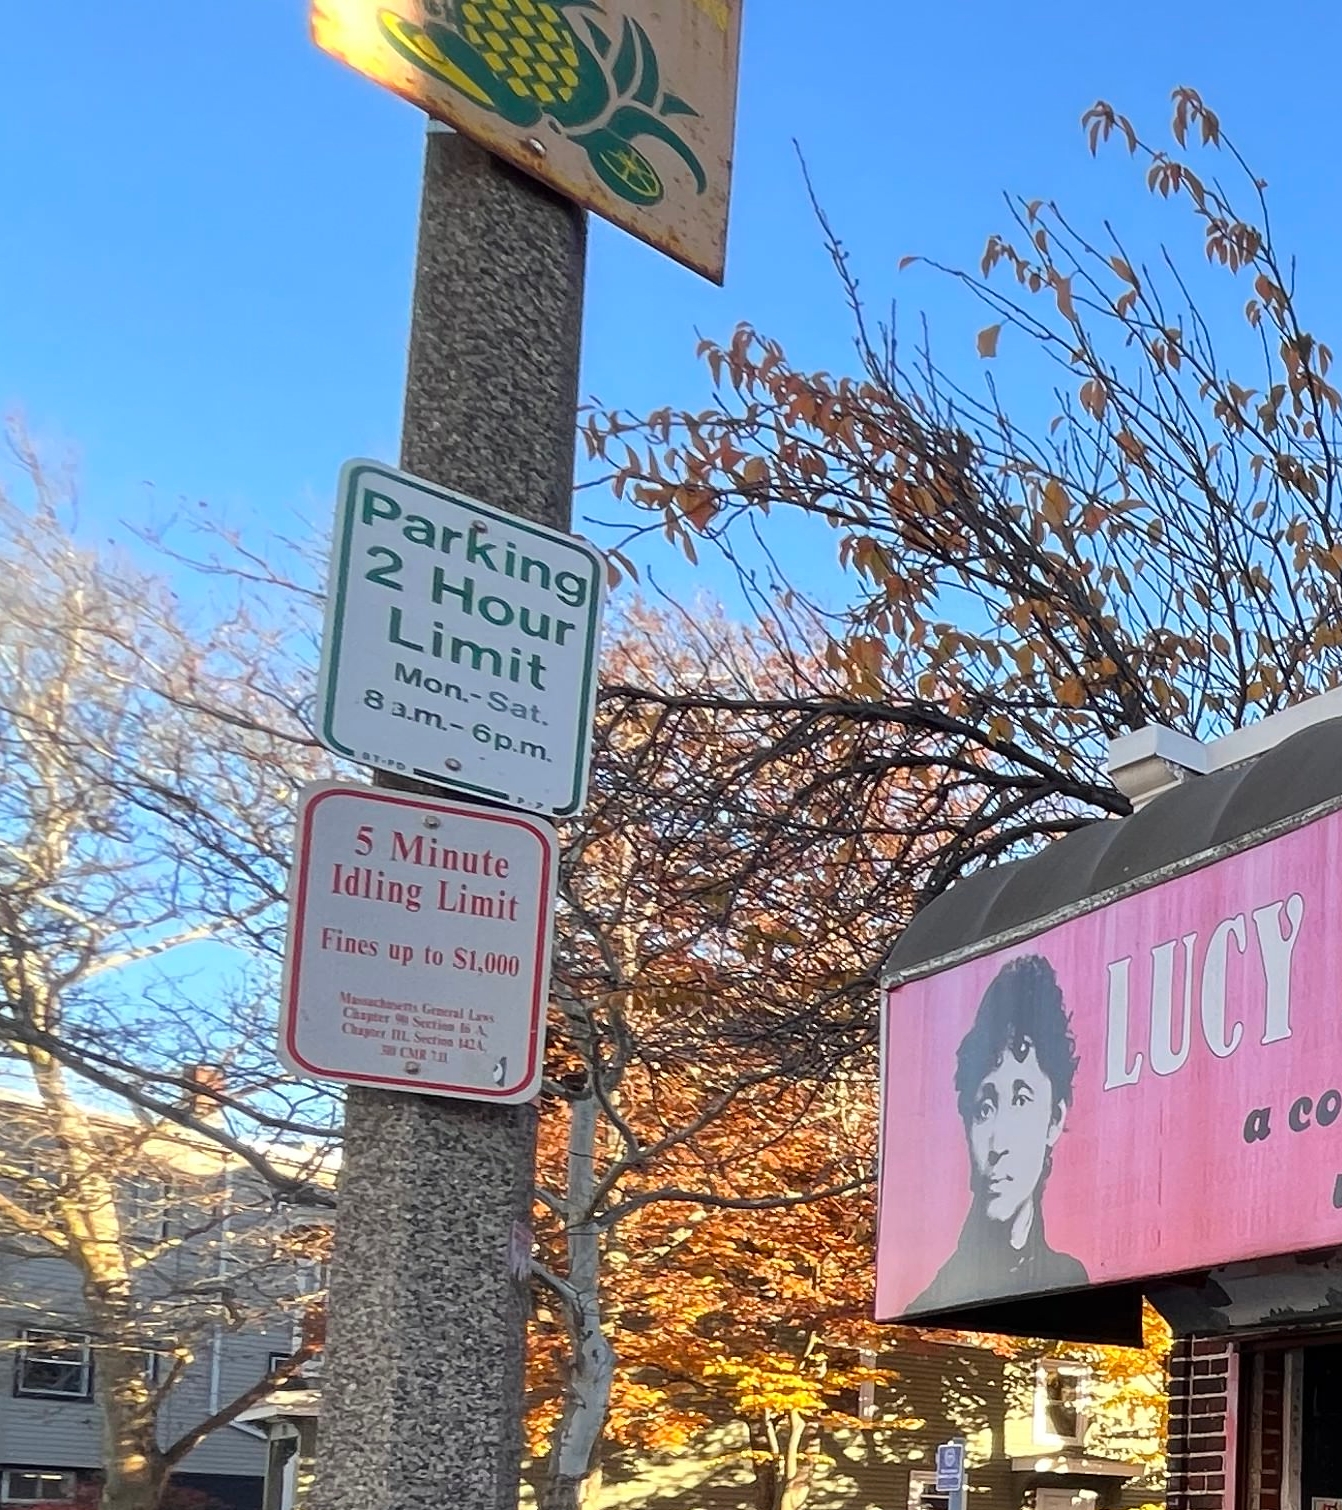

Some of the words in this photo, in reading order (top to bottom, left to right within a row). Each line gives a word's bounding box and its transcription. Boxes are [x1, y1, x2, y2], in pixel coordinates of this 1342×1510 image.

[361, 488, 588, 608] Parking
[364, 546, 404, 592] 2
[431, 566, 576, 646] Hour
[388, 606, 547, 691] Limit
[362, 689, 384, 710] 8
[355, 825, 374, 856] 5
[390, 831, 510, 879] Minute
[332, 863, 422, 913] Idling
[437, 880, 519, 921] Limit
[321, 927, 378, 957] Fines
[389, 944, 414, 966] up
[425, 944, 444, 966] to
[452, 947, 520, 977] $1,000
[1103, 893, 1305, 1092] LUCY
[1243, 1107, 1271, 1144] a
